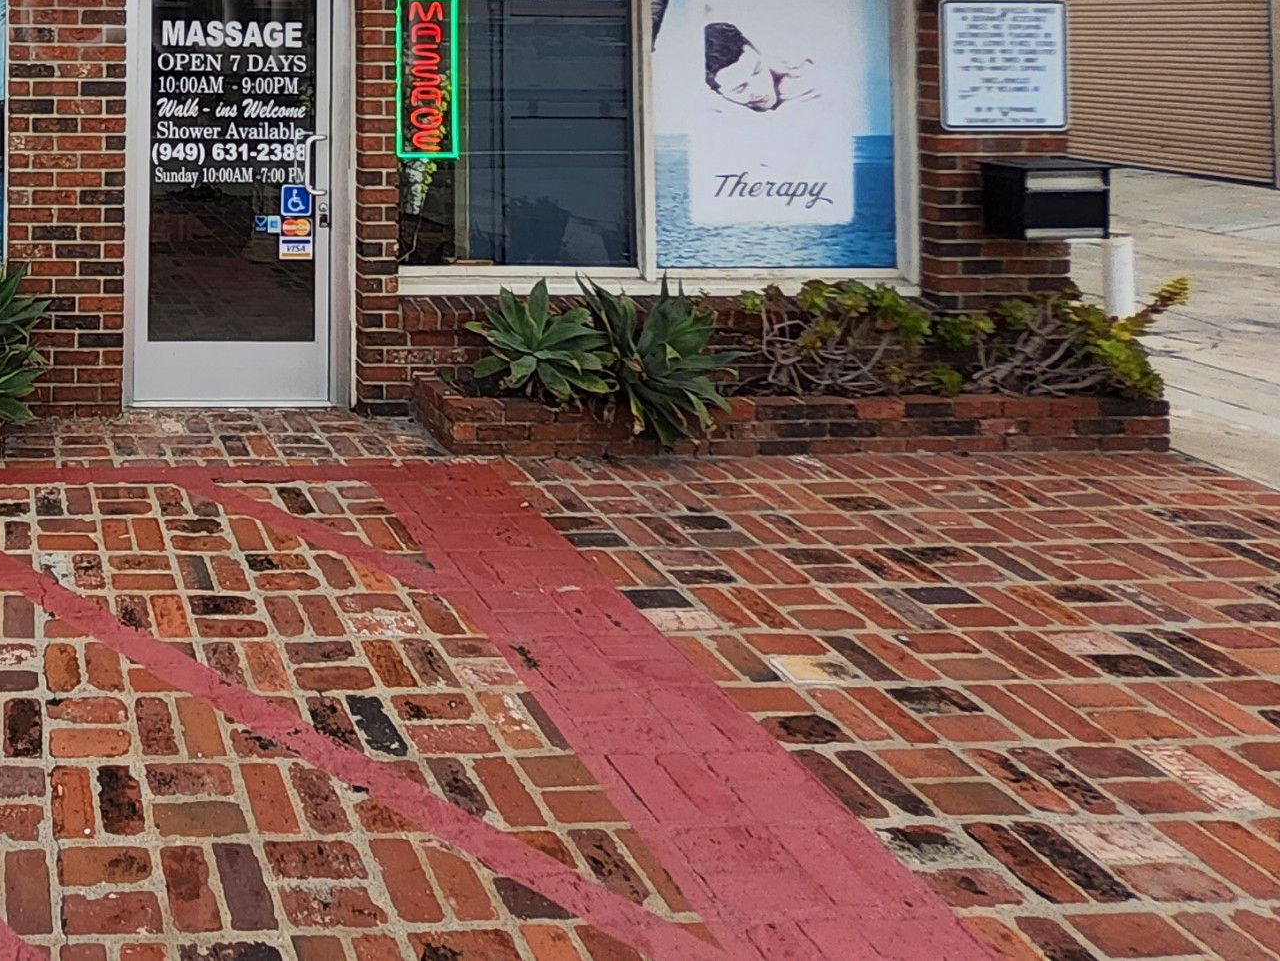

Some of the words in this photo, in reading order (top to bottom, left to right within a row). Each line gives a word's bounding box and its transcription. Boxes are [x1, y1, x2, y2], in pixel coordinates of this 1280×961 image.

[161, 20, 303, 48] MASSAGE
[157, 53, 223, 71] OPEN
[230, 54, 240, 71] 7
[247, 54, 307, 72] DAYS
[158, 76, 224, 94] 10:00AM
[242, 77, 299, 94] 9:00PM
[408, 1, 443, 150] MASSAGE
[156, 97, 199, 118] Walk
[215, 101, 237, 118] ins
[241, 98, 306, 118] Welcome
[156, 121, 221, 139] Shower
[226, 122, 305, 140] Available
[151, 142, 205, 165] (949)
[212, 143, 306, 161] 631-2388
[155, 167, 199, 188] Sunday
[202, 168, 253, 183] 10:00AM
[714, 171, 833, 209] Therapy
